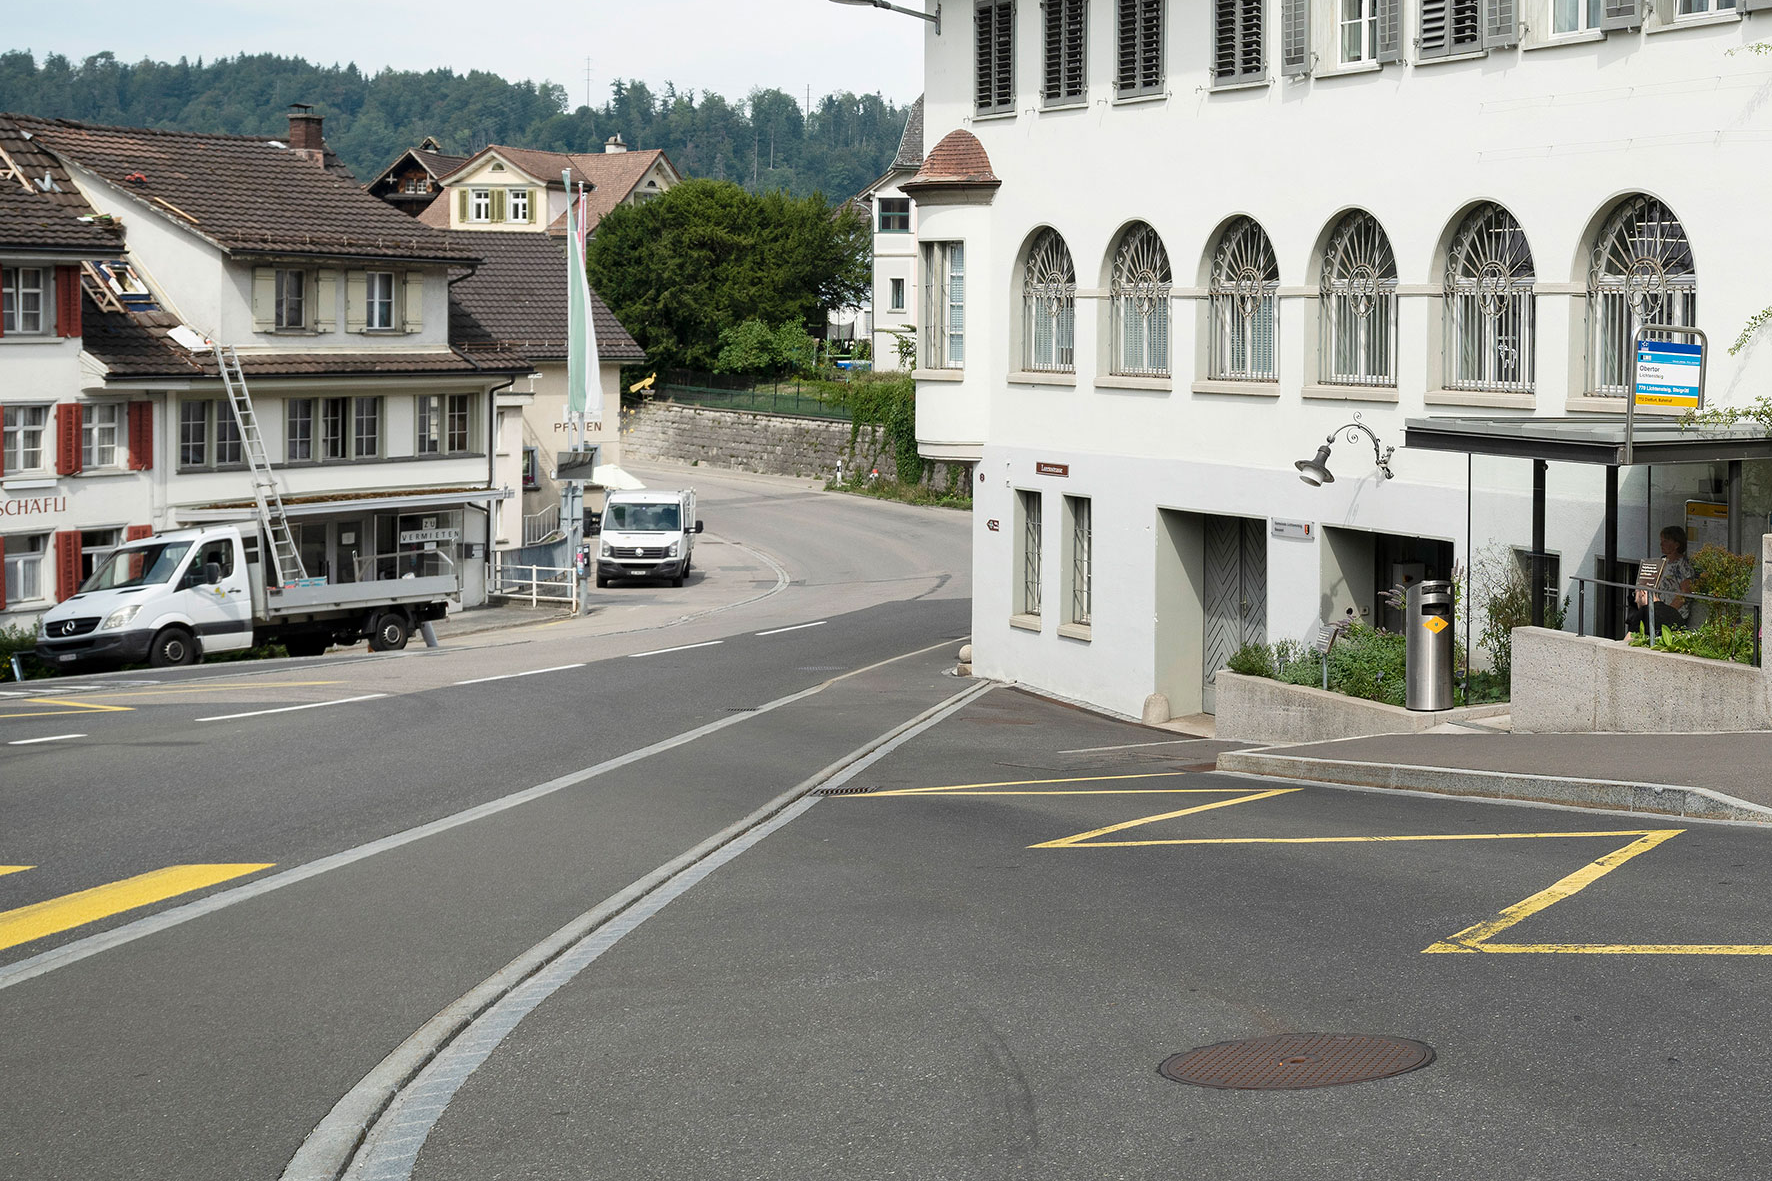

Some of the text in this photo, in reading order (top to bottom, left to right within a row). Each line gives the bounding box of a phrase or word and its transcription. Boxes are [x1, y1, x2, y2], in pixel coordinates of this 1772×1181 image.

[1639, 365, 1660, 373] Obertor
[1639, 372, 1664, 380] Lichtensteig
[554, 421, 602, 433] PFAEN
[402, 530, 459, 541] VERMIETEN
